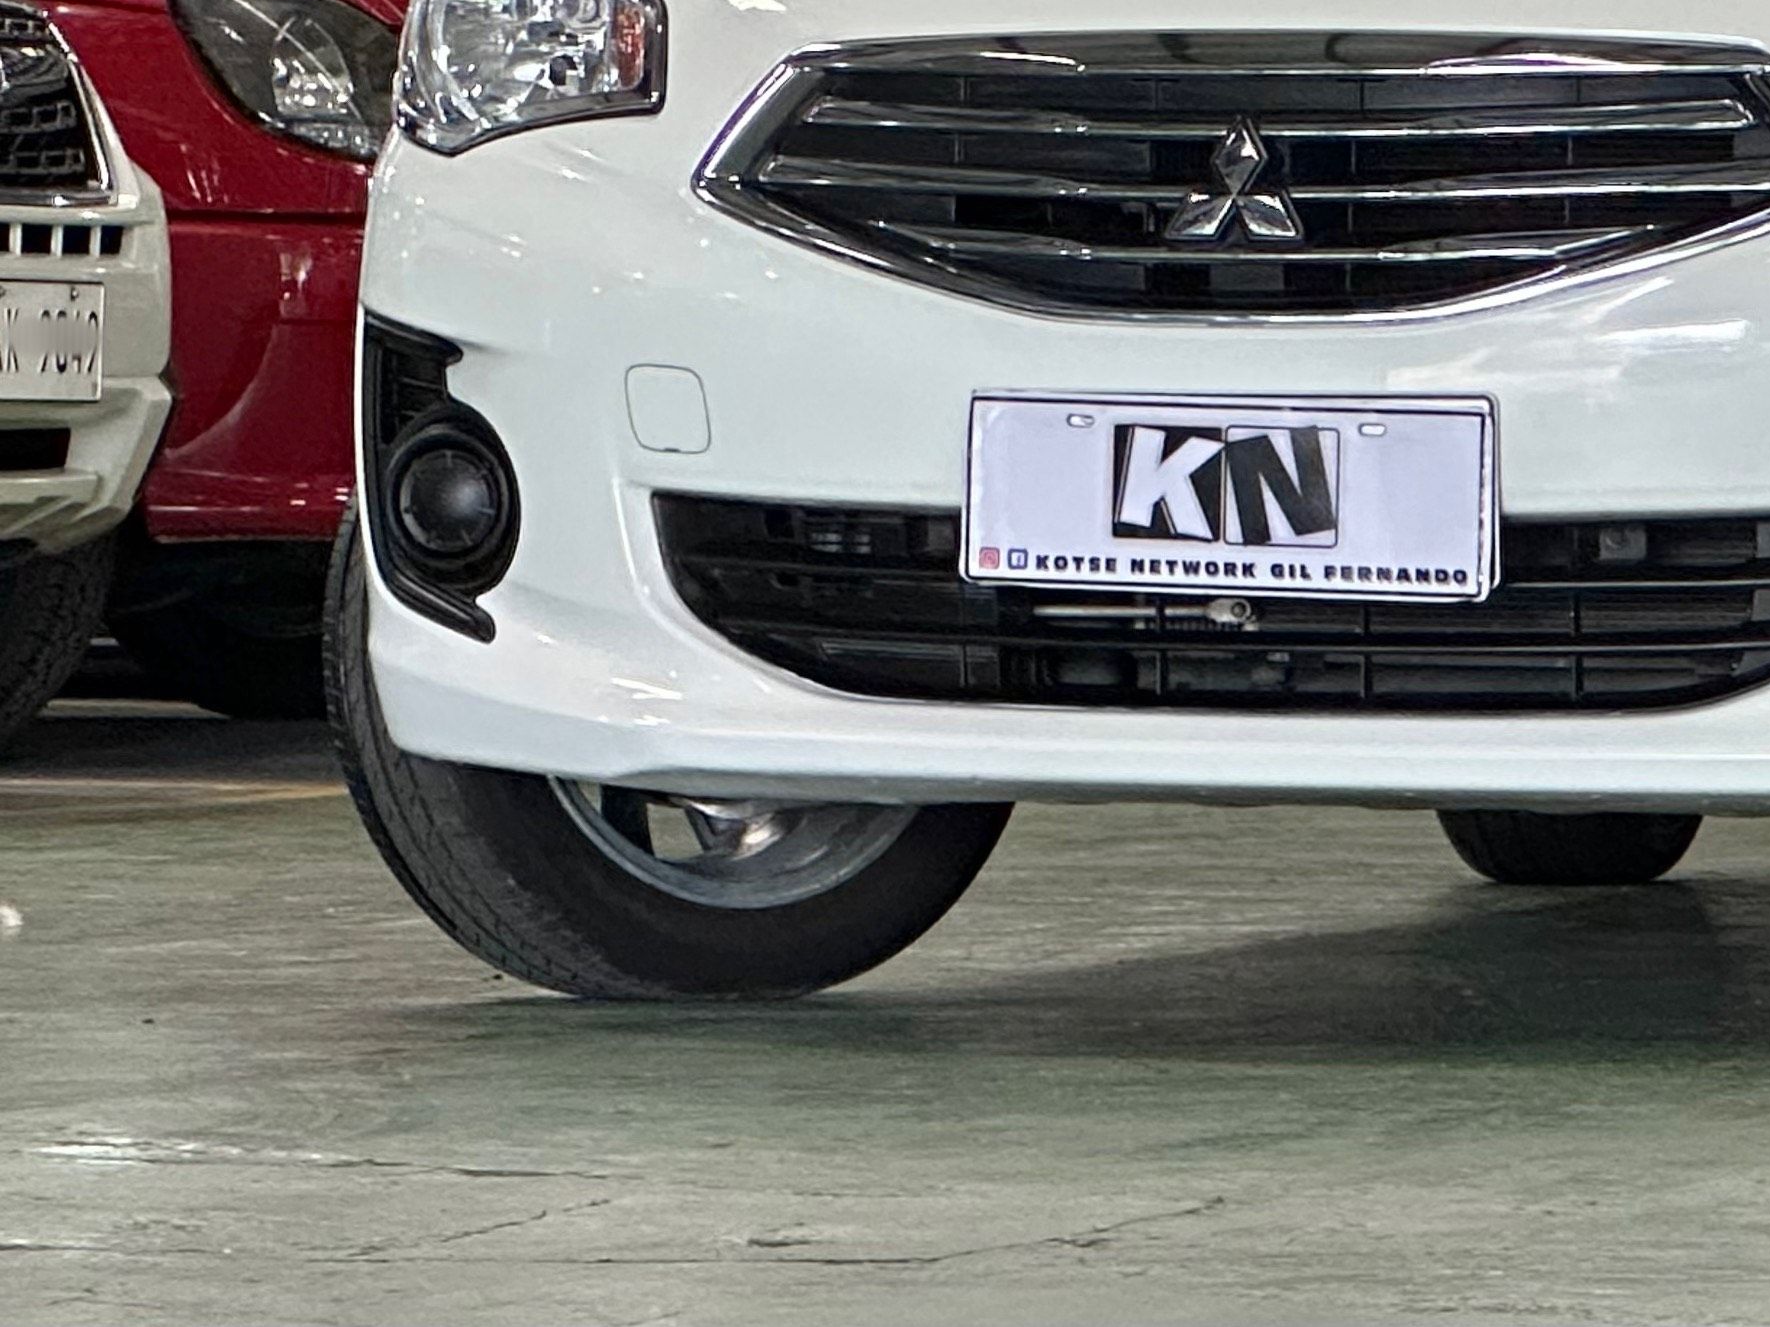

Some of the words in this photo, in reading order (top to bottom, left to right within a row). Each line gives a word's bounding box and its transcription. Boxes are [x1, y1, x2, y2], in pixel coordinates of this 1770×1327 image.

[1117, 425, 1335, 546] KN
[1036, 553, 1117, 574] KOTSE
[1130, 557, 1256, 579] NETWORK
[1271, 562, 1312, 580] GIL
[1323, 564, 1469, 586] FERNANDO
